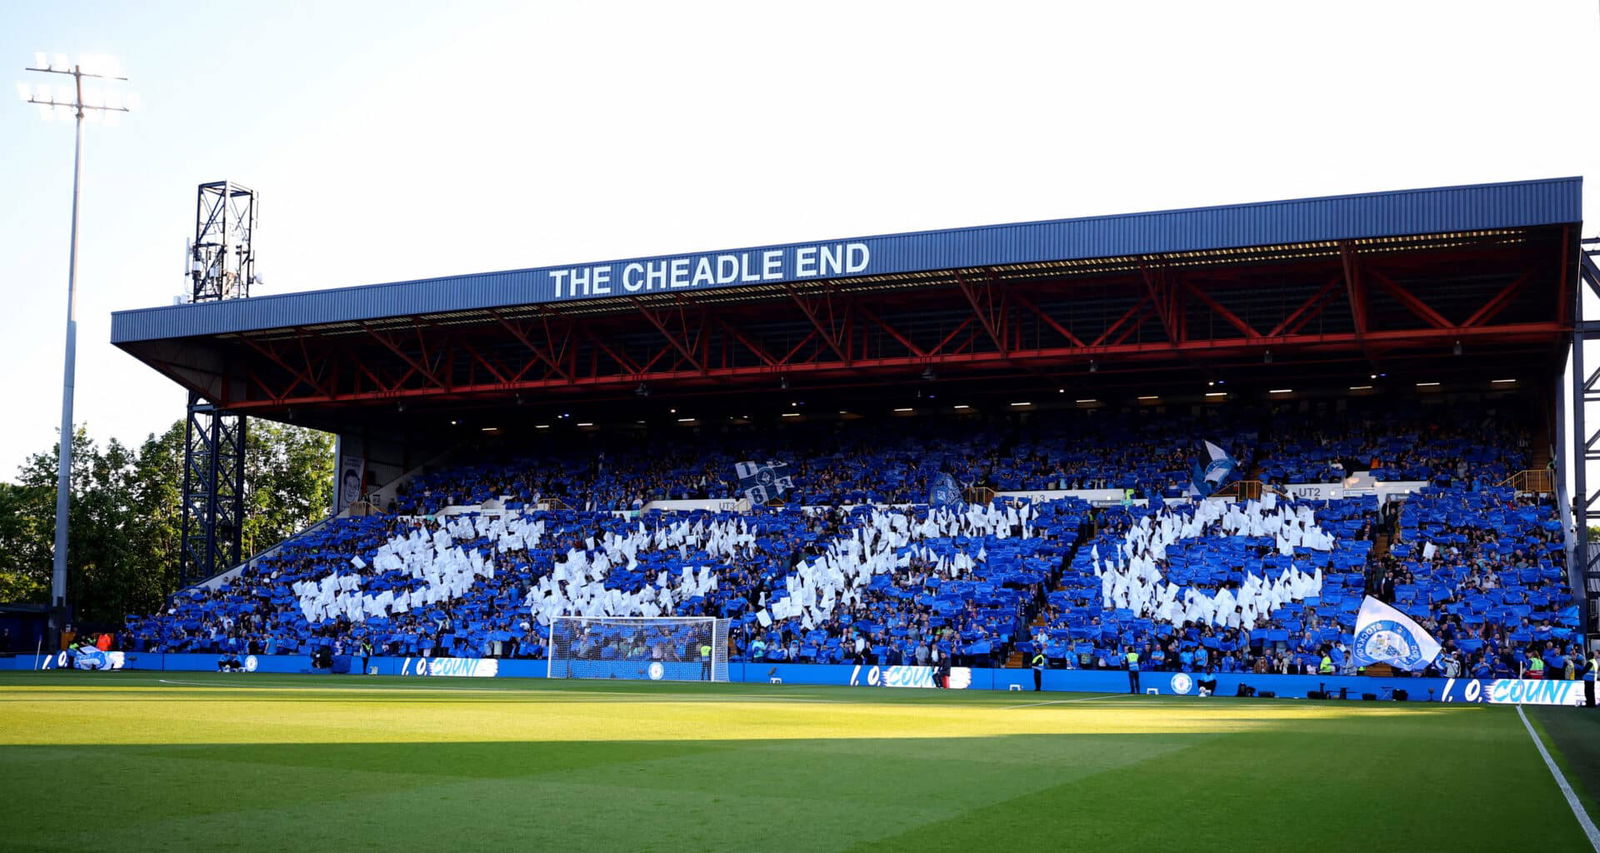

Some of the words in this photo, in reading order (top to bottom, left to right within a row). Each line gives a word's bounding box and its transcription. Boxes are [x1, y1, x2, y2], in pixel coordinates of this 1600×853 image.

[549, 266, 611, 297] THE
[622, 250, 783, 291] CHEADLE
[796, 243, 870, 277] END
[1299, 488, 1320, 497] UT2
